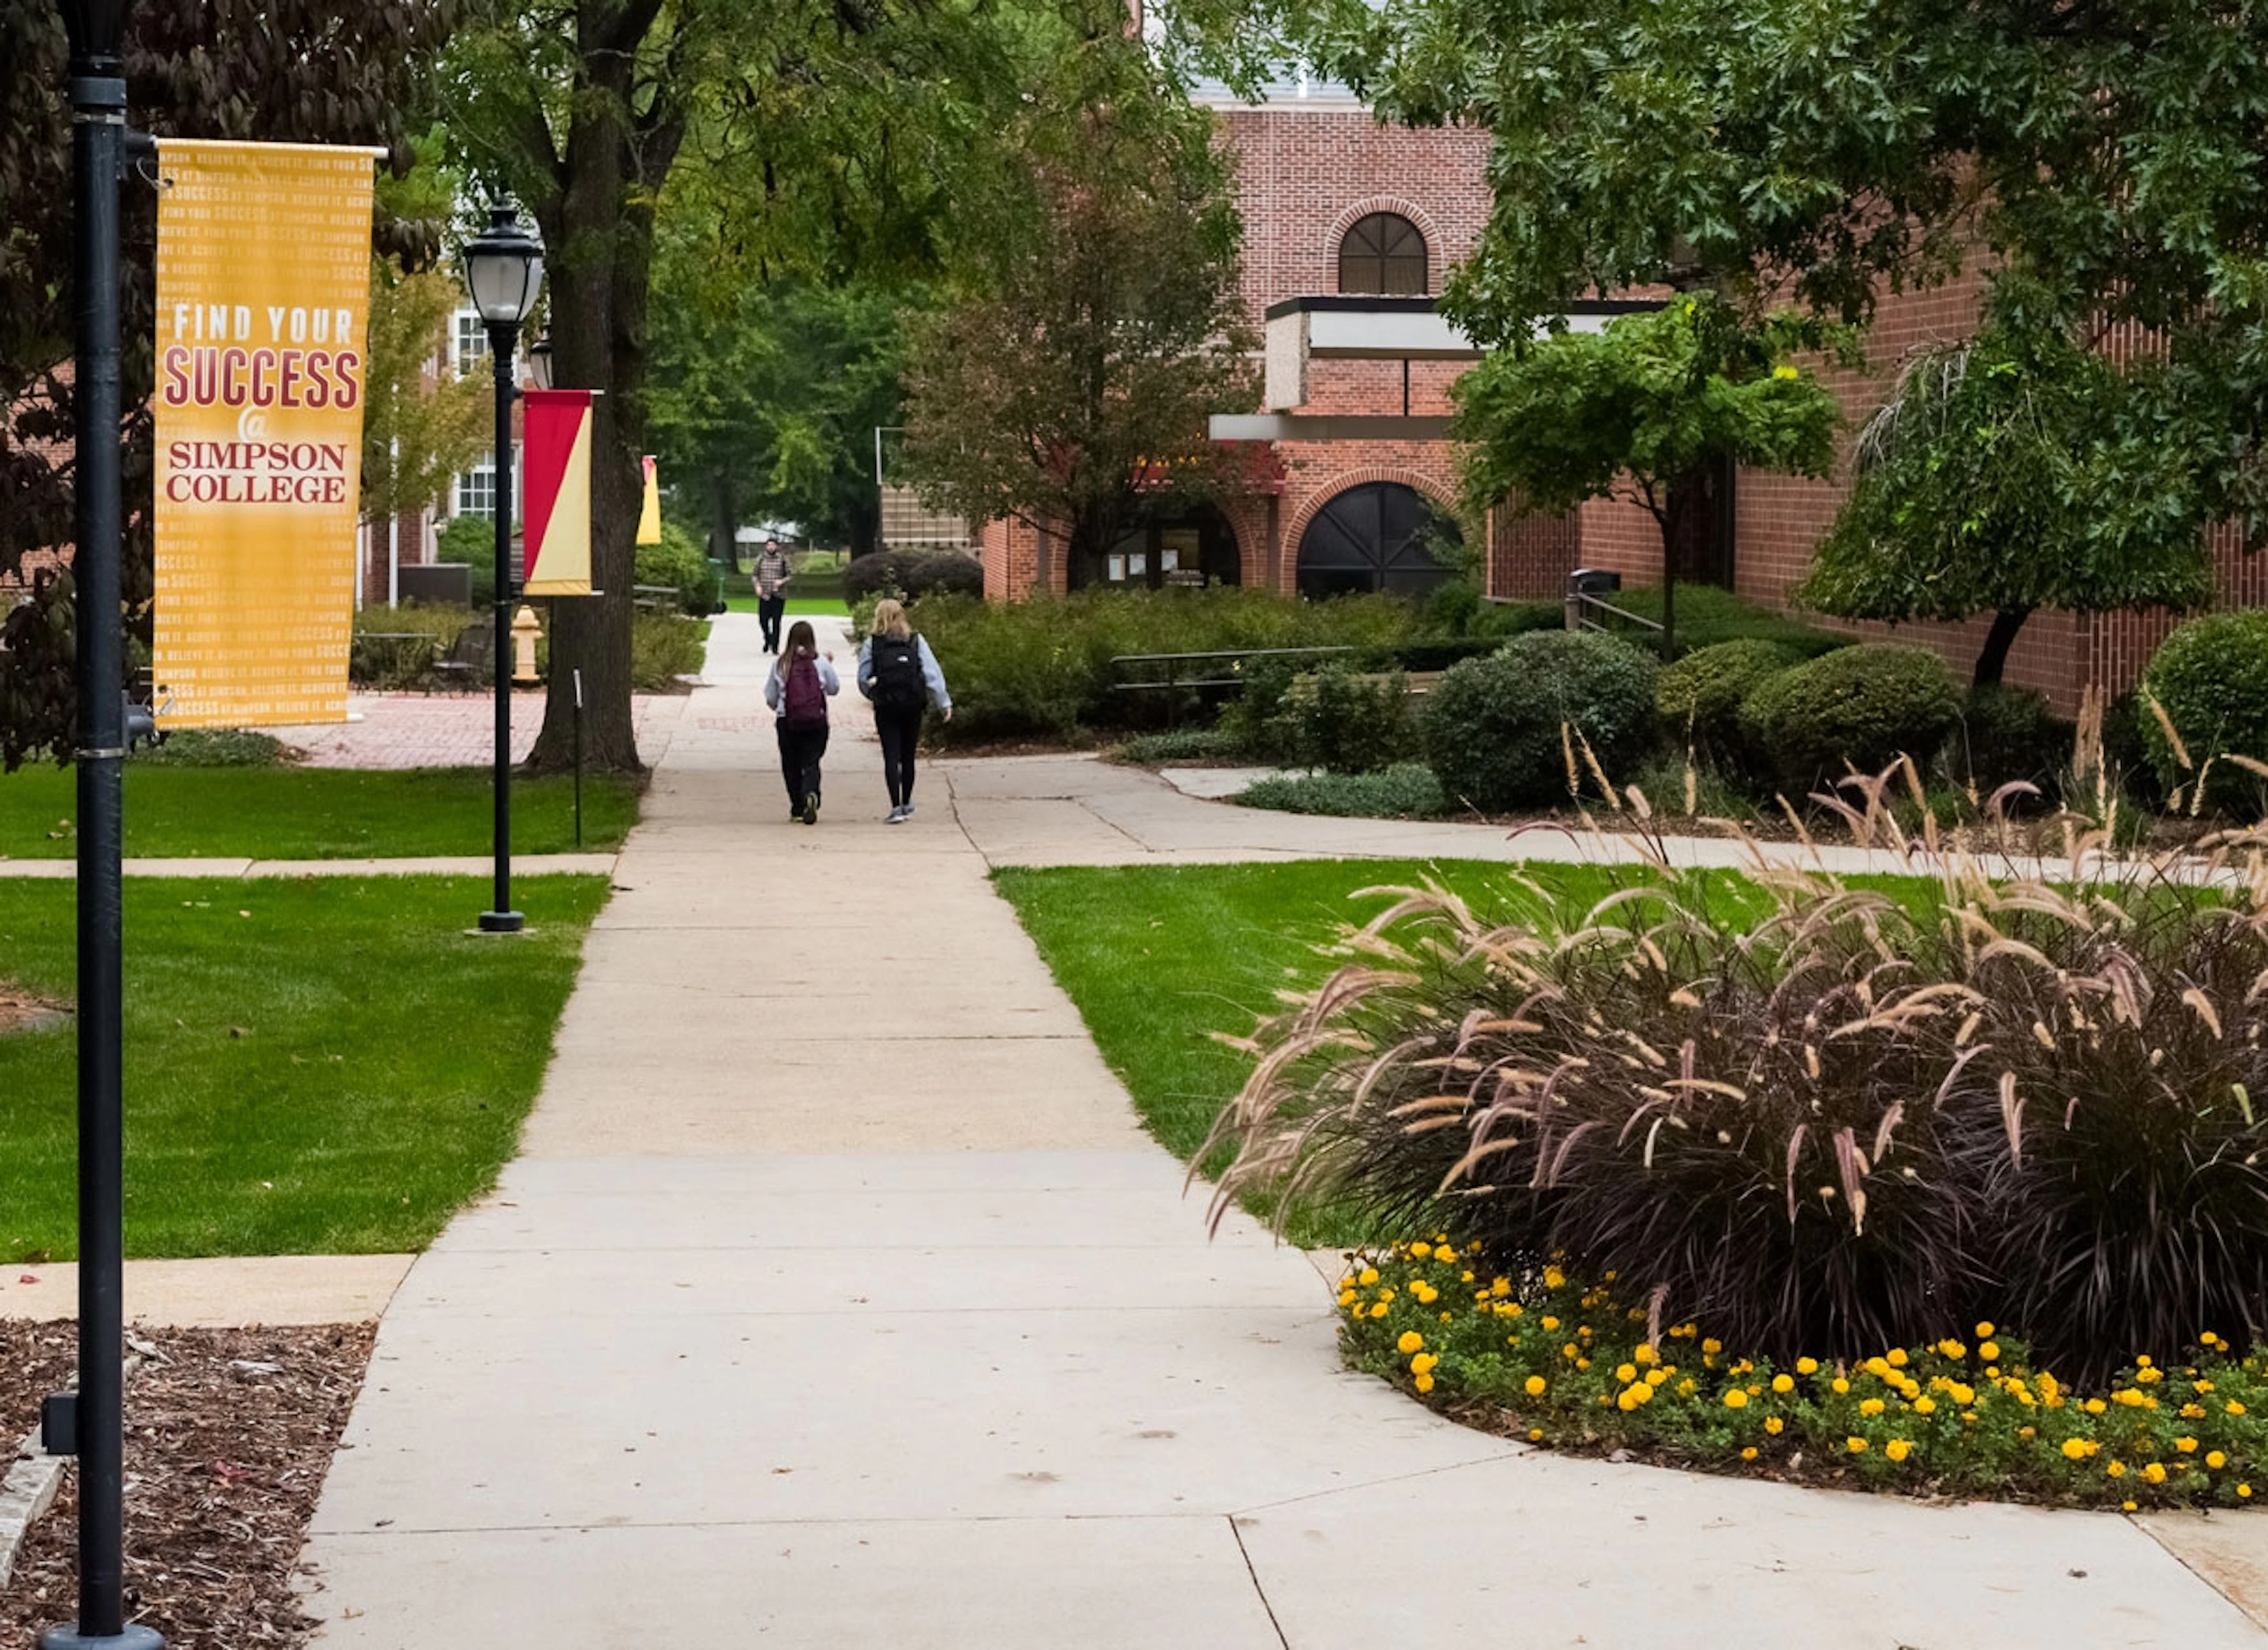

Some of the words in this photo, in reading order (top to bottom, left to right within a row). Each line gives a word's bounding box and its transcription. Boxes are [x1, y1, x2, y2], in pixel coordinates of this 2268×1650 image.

[175, 186, 229, 202] SUCCESS
[174, 304, 251, 342] FIND
[268, 307, 352, 344] YOUR
[164, 345, 360, 409] SUCCESS
[237, 406, 269, 443] @
[170, 441, 348, 471] SIMPSON
[167, 475, 346, 503] COLLEGE
